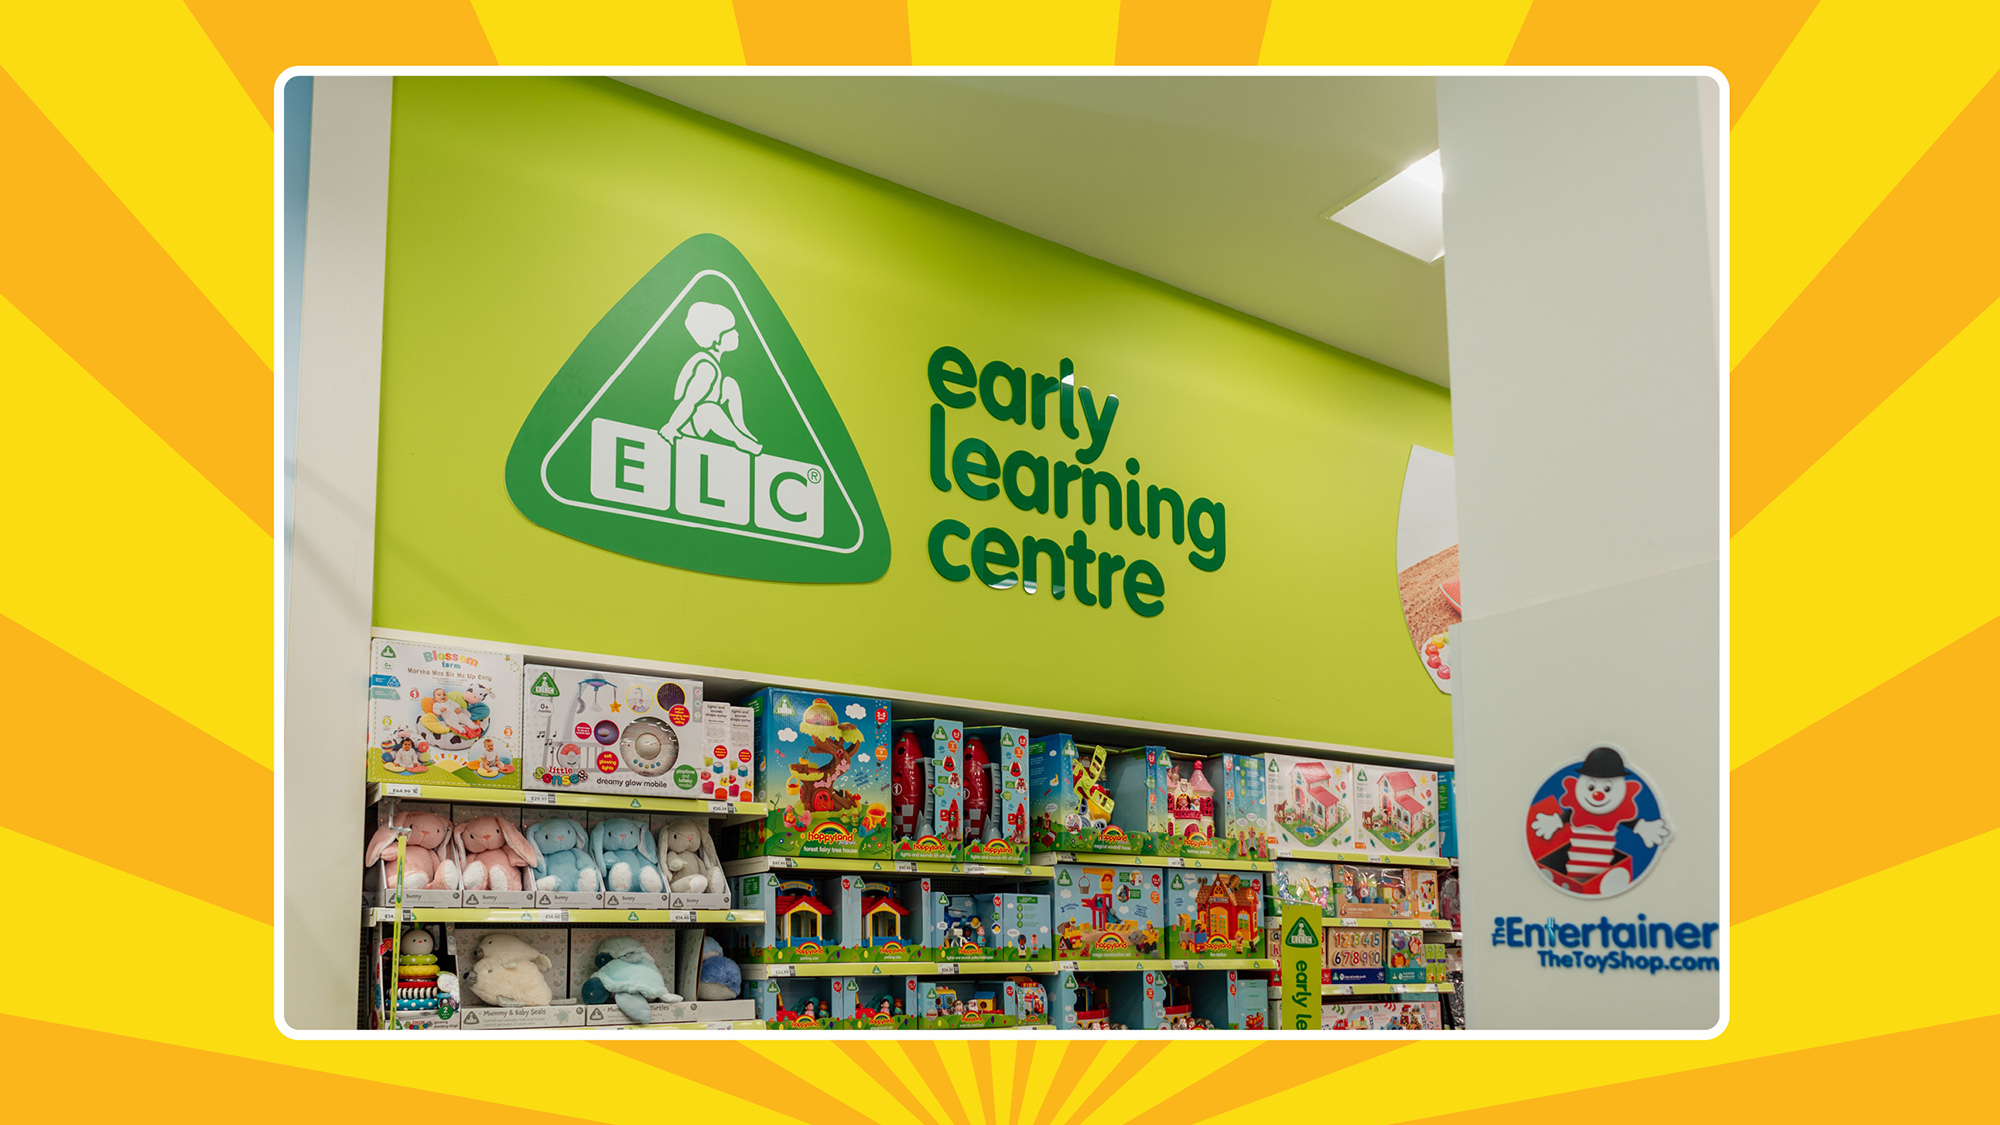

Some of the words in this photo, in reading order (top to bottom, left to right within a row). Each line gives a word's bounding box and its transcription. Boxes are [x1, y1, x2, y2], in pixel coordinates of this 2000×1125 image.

[927, 346, 1119, 464] early
[930, 403, 1226, 572] learning
[928, 518, 1165, 617] centre
[423, 650, 479, 668] Blossom
[441, 661, 461, 669] farm
[548, 765, 573, 774] little
[596, 777, 624, 787] dreamy
[625, 779, 642, 788] glow
[643, 779, 668, 788] mobile
[894, 785, 899, 794] 1
[808, 831, 854, 845] happyland
[1098, 833, 1128, 844] happyland
[1184, 838, 1213, 848] happyland
[819, 846, 831, 854] fairy
[913, 843, 946, 852] happyland
[982, 846, 1013, 855] happyland
[406, 893, 422, 901] Bunny
[482, 894, 498, 902] Bunny
[554, 894, 569, 902] Bunny
[1505, 913, 1720, 950] Entertainer
[1336, 932, 1341, 946] 1
[1344, 933, 1350, 947] 2
[1354, 933, 1360, 946] 3
[1363, 933, 1370, 946] 4
[1373, 933, 1380, 946] 5
[795, 947, 823, 956] happyland
[880, 947, 906, 955] happyland
[958, 947, 983, 956] happyland
[1095, 941, 1128, 952] happyland
[1205, 942, 1232, 952] happyland
[1334, 951, 1342, 965] 6
[1344, 951, 1351, 965] 7
[1352, 951, 1360, 965] 8
[1362, 951, 1368, 965] 9
[1371, 951, 1381, 964] 10
[1536, 949, 1720, 975] TheToyShop.com
[1291, 960, 1312, 1008] early
[483, 1010, 508, 1018] Mummy
[515, 1008, 529, 1017] Baby
[791, 1019, 819, 1029] happyland
[868, 1018, 895, 1026] happyland
